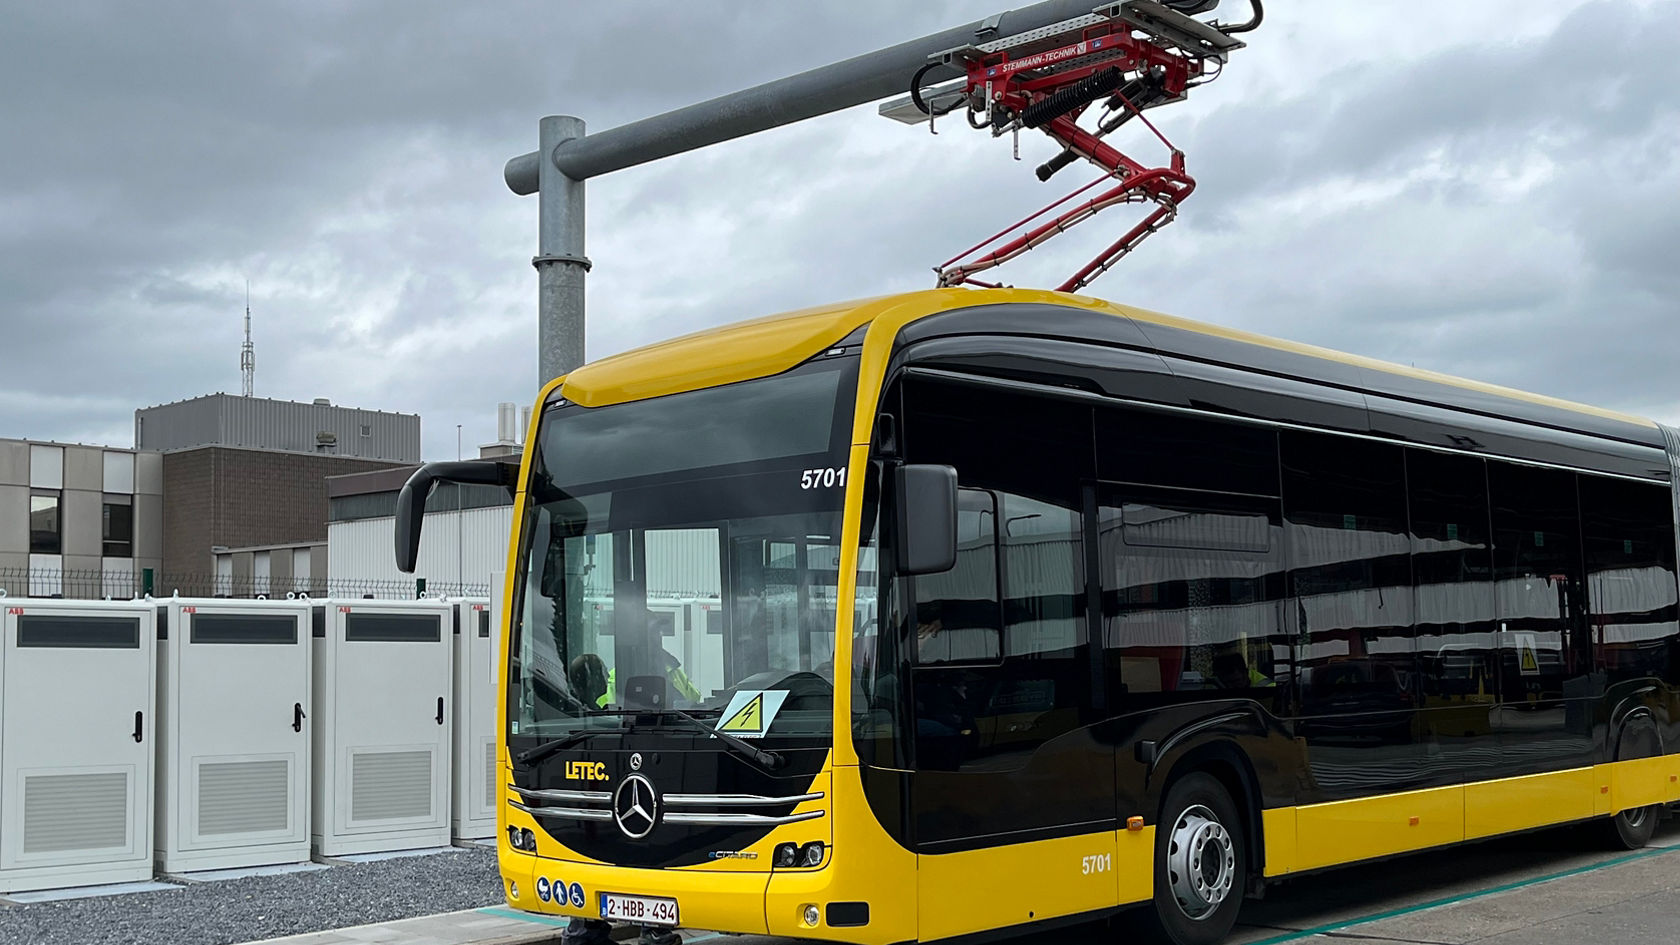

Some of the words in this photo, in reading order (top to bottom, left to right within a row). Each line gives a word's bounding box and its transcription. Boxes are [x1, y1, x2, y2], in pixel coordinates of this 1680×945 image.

[1002, 46, 1077, 73] STEMMANN-TECHNIK
[801, 467, 846, 490] 5701
[9, 607, 24, 615] ABB
[565, 761, 610, 781] LETEC.
[1082, 852, 1112, 875] 5701
